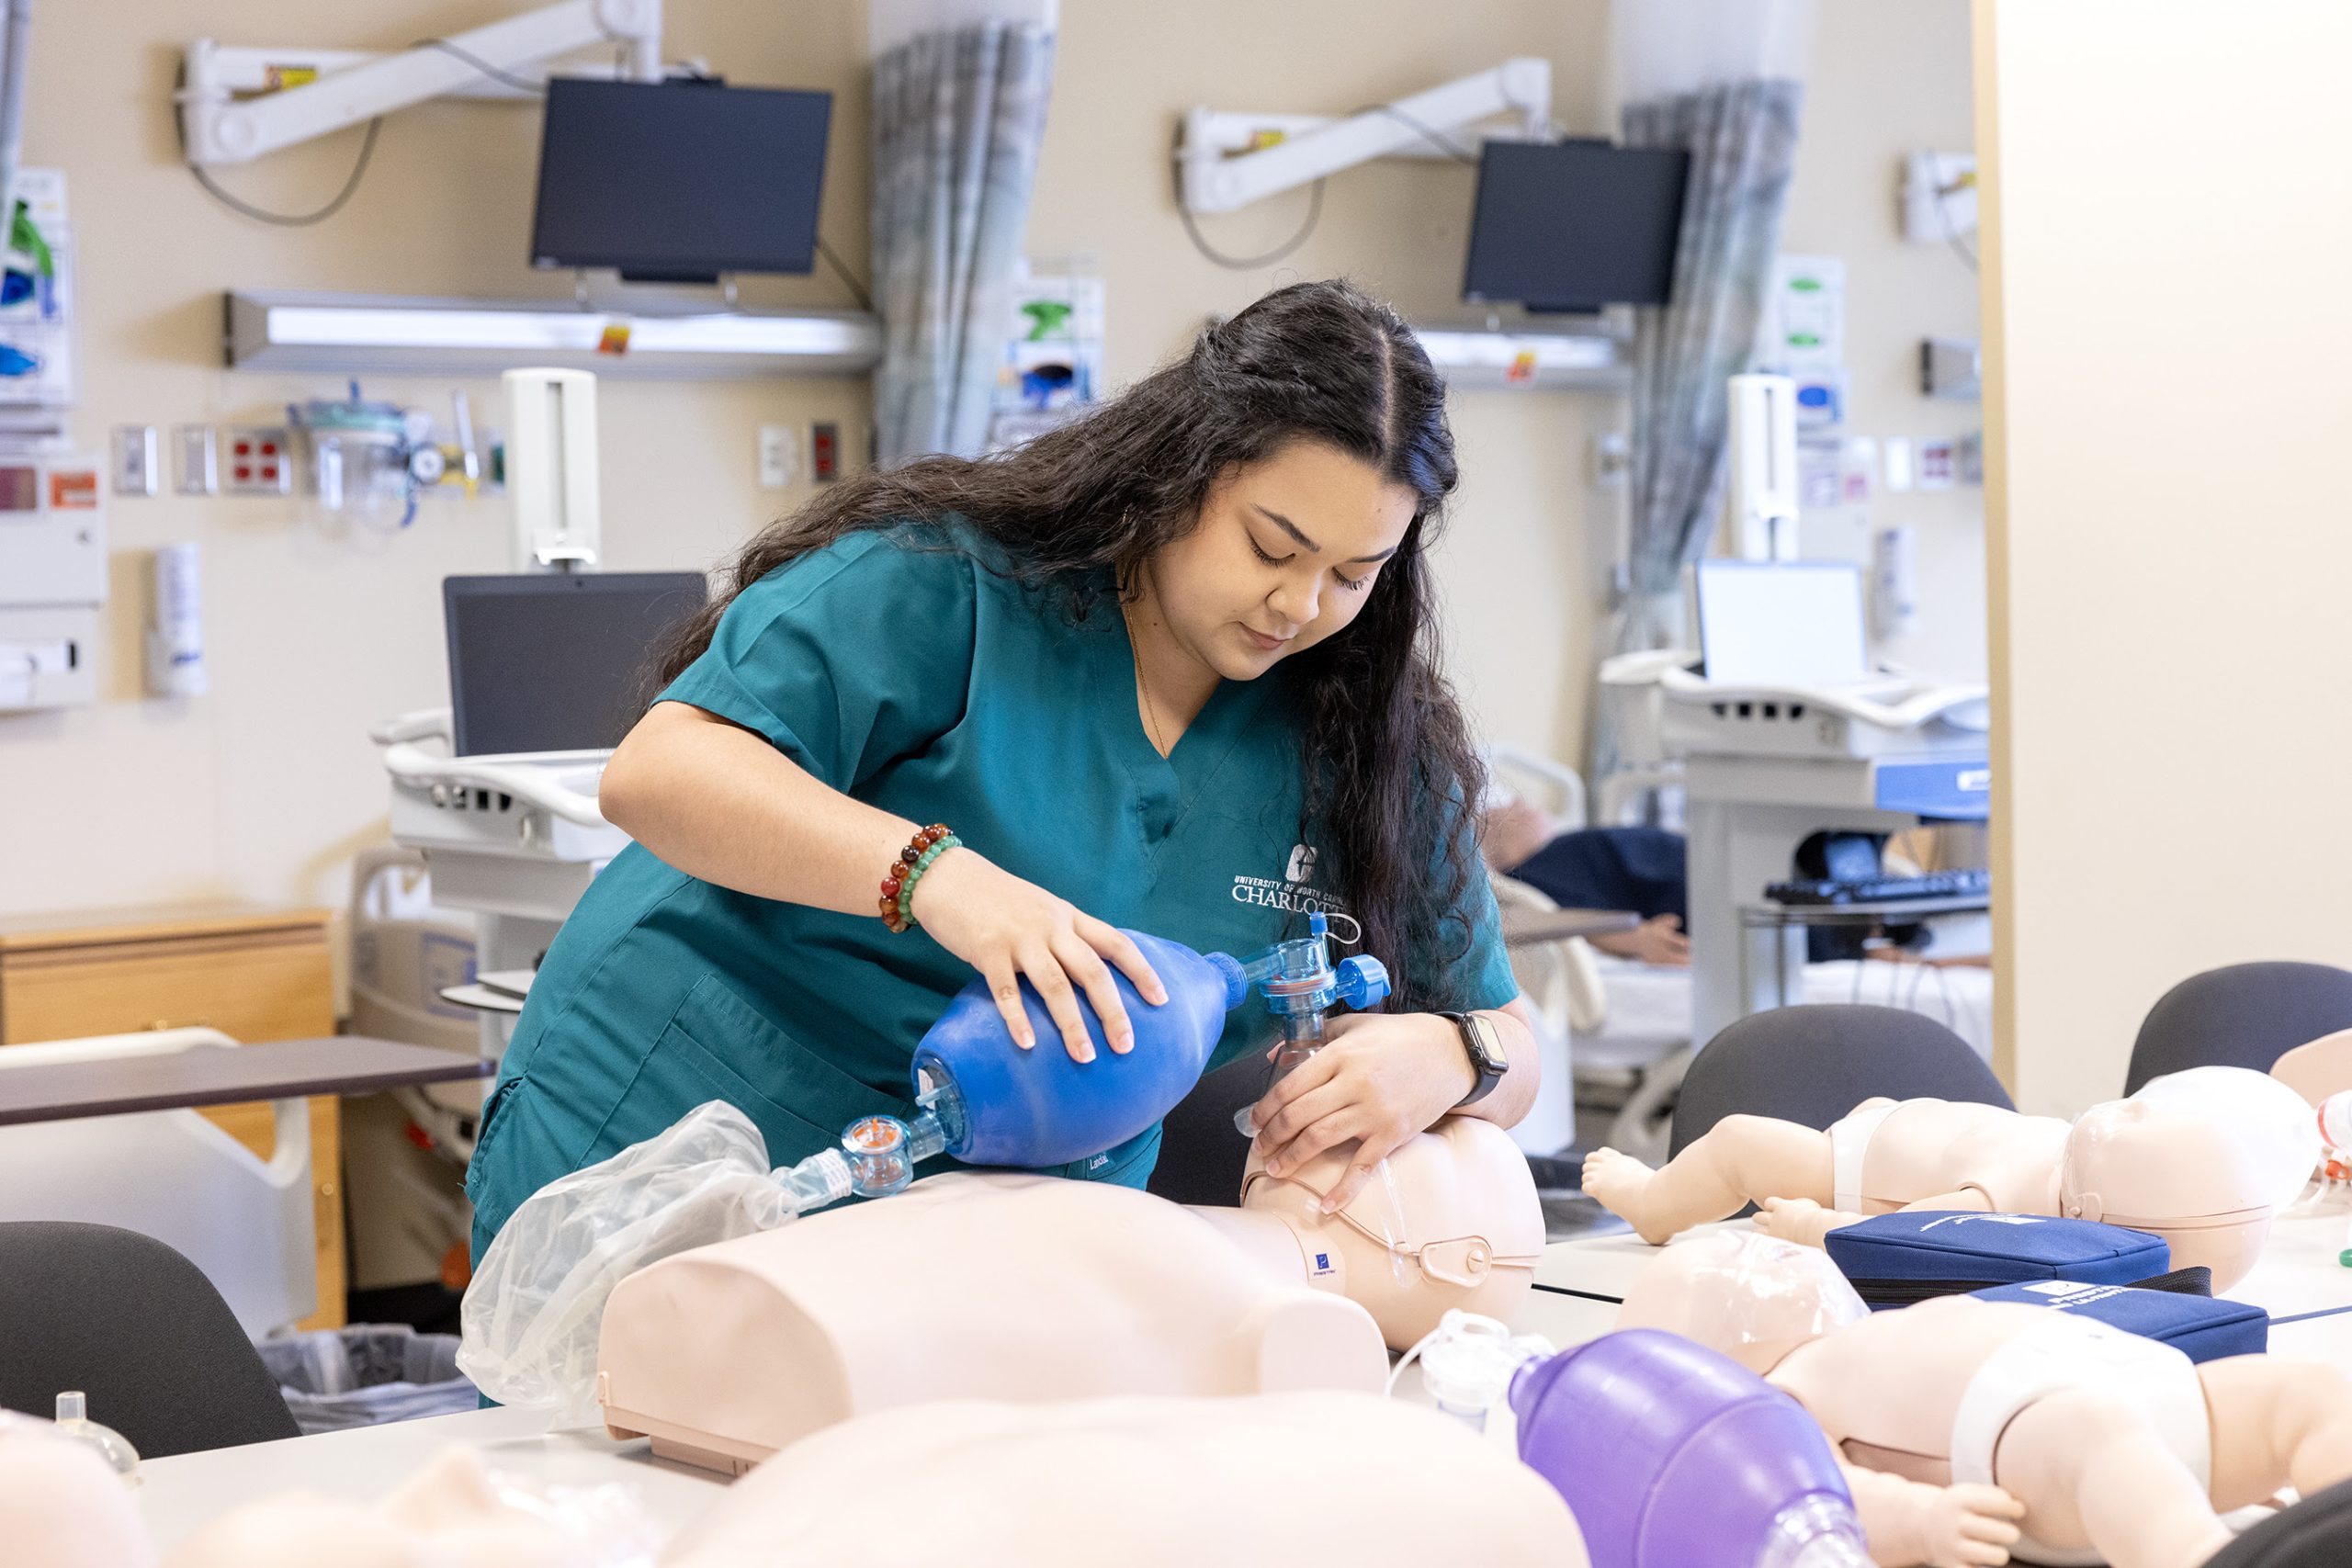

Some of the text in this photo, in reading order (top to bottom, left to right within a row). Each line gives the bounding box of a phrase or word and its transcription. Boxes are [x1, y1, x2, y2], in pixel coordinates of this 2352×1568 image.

[1234, 874, 1282, 890] UNIVERSITY
[1283, 883, 1295, 893] OF
[1232, 884, 1351, 925] CHARLOTT
